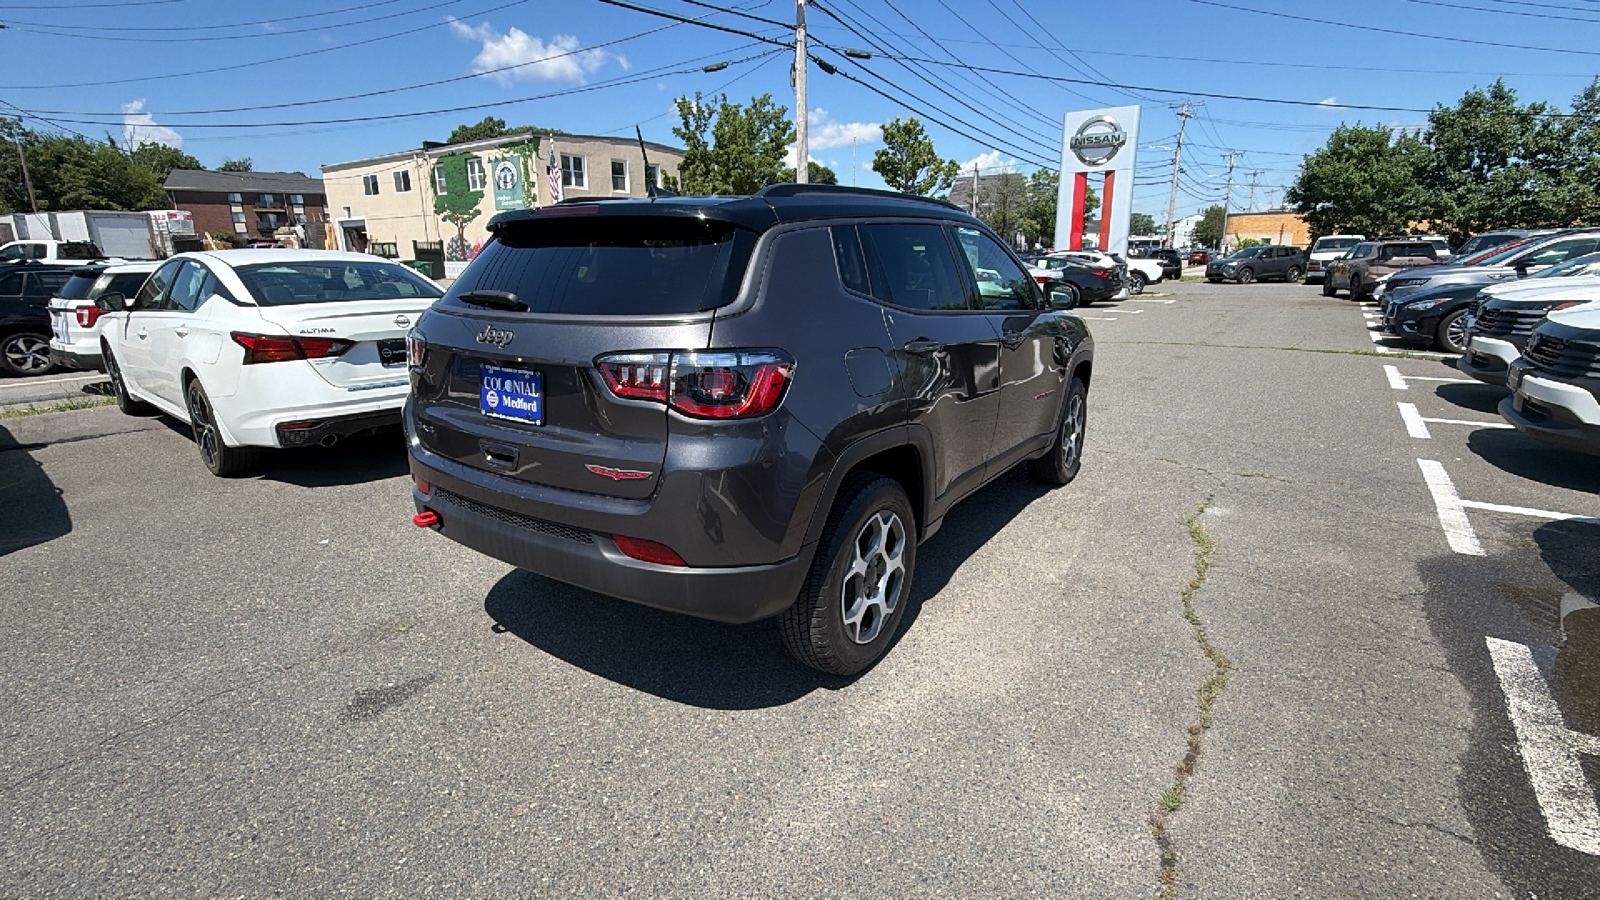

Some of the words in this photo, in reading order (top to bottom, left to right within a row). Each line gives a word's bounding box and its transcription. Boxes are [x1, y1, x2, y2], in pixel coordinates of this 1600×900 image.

[1074, 134, 1121, 146] NISSAN
[476, 324, 514, 350] Jeep
[483, 376, 539, 398] COLONIAL
[502, 394, 538, 412] Medford
